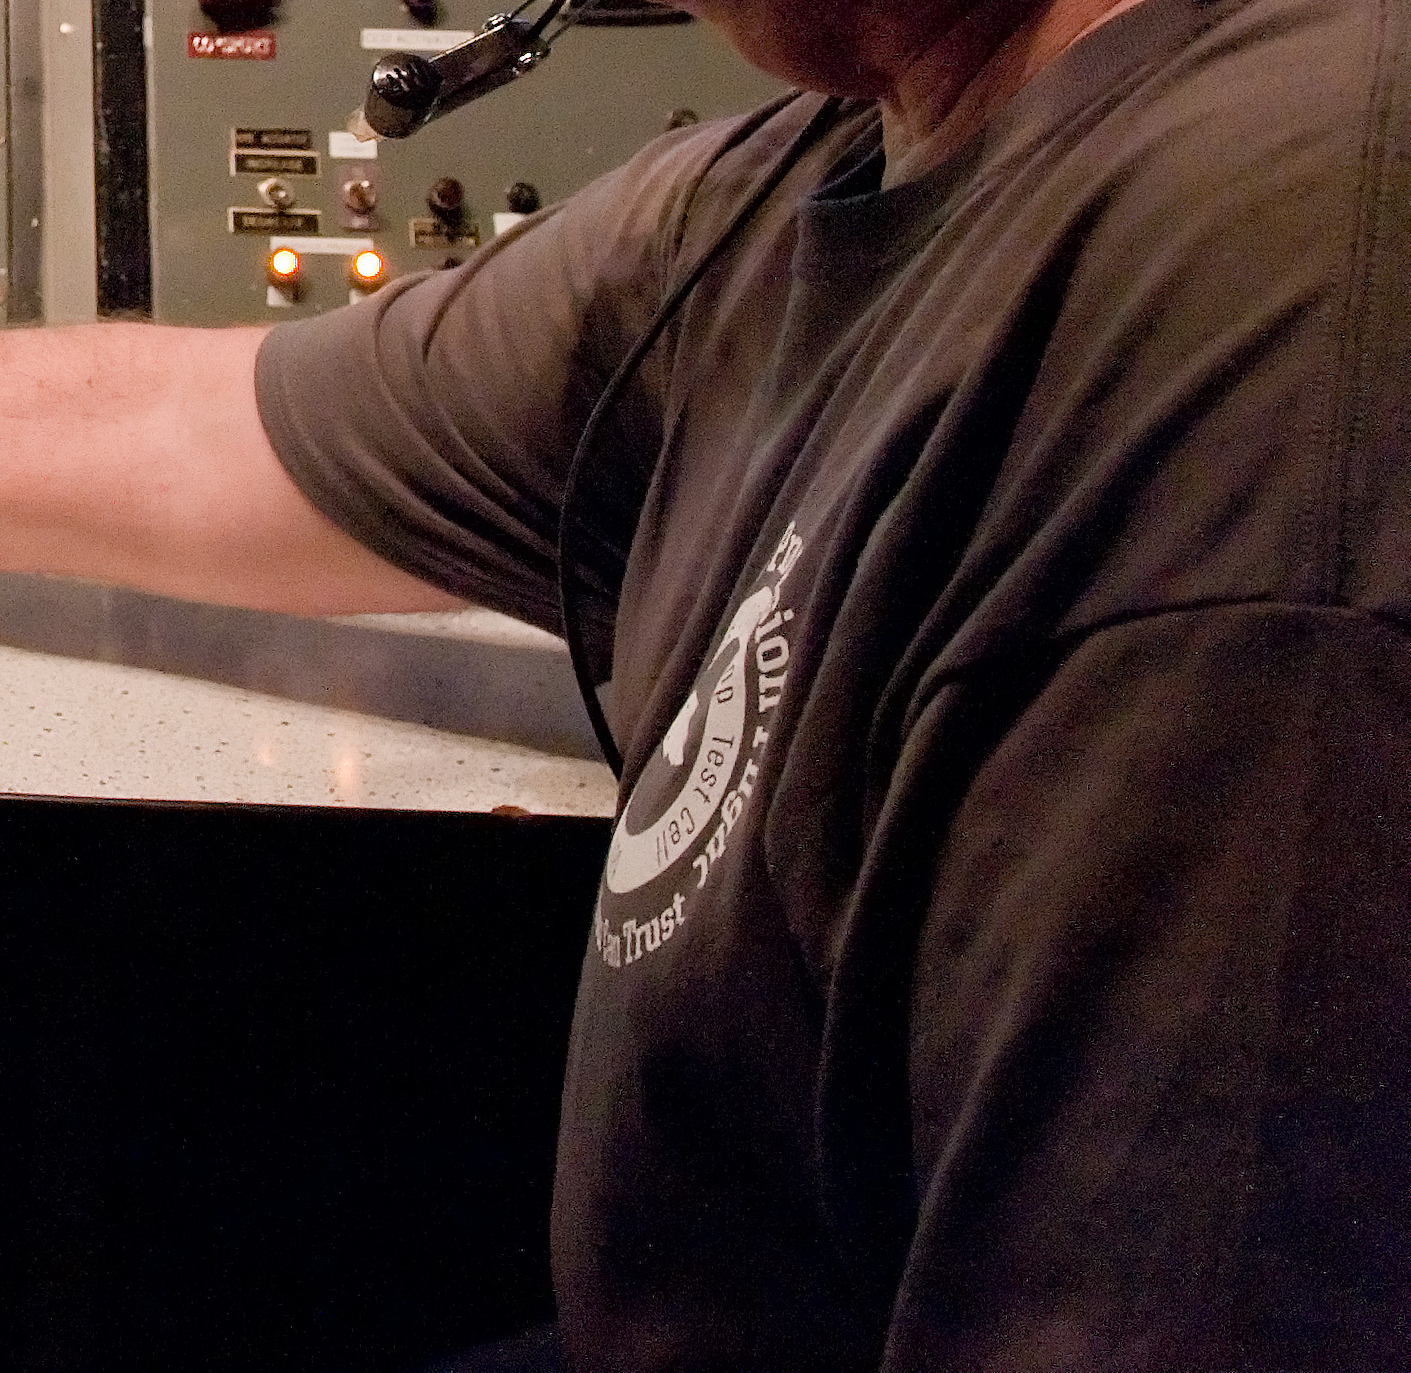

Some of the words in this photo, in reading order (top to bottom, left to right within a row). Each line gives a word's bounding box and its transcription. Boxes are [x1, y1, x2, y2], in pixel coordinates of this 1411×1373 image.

[693, 736, 735, 804] Test
[655, 807, 696, 867] Cell
[623, 892, 686, 965] Trust
